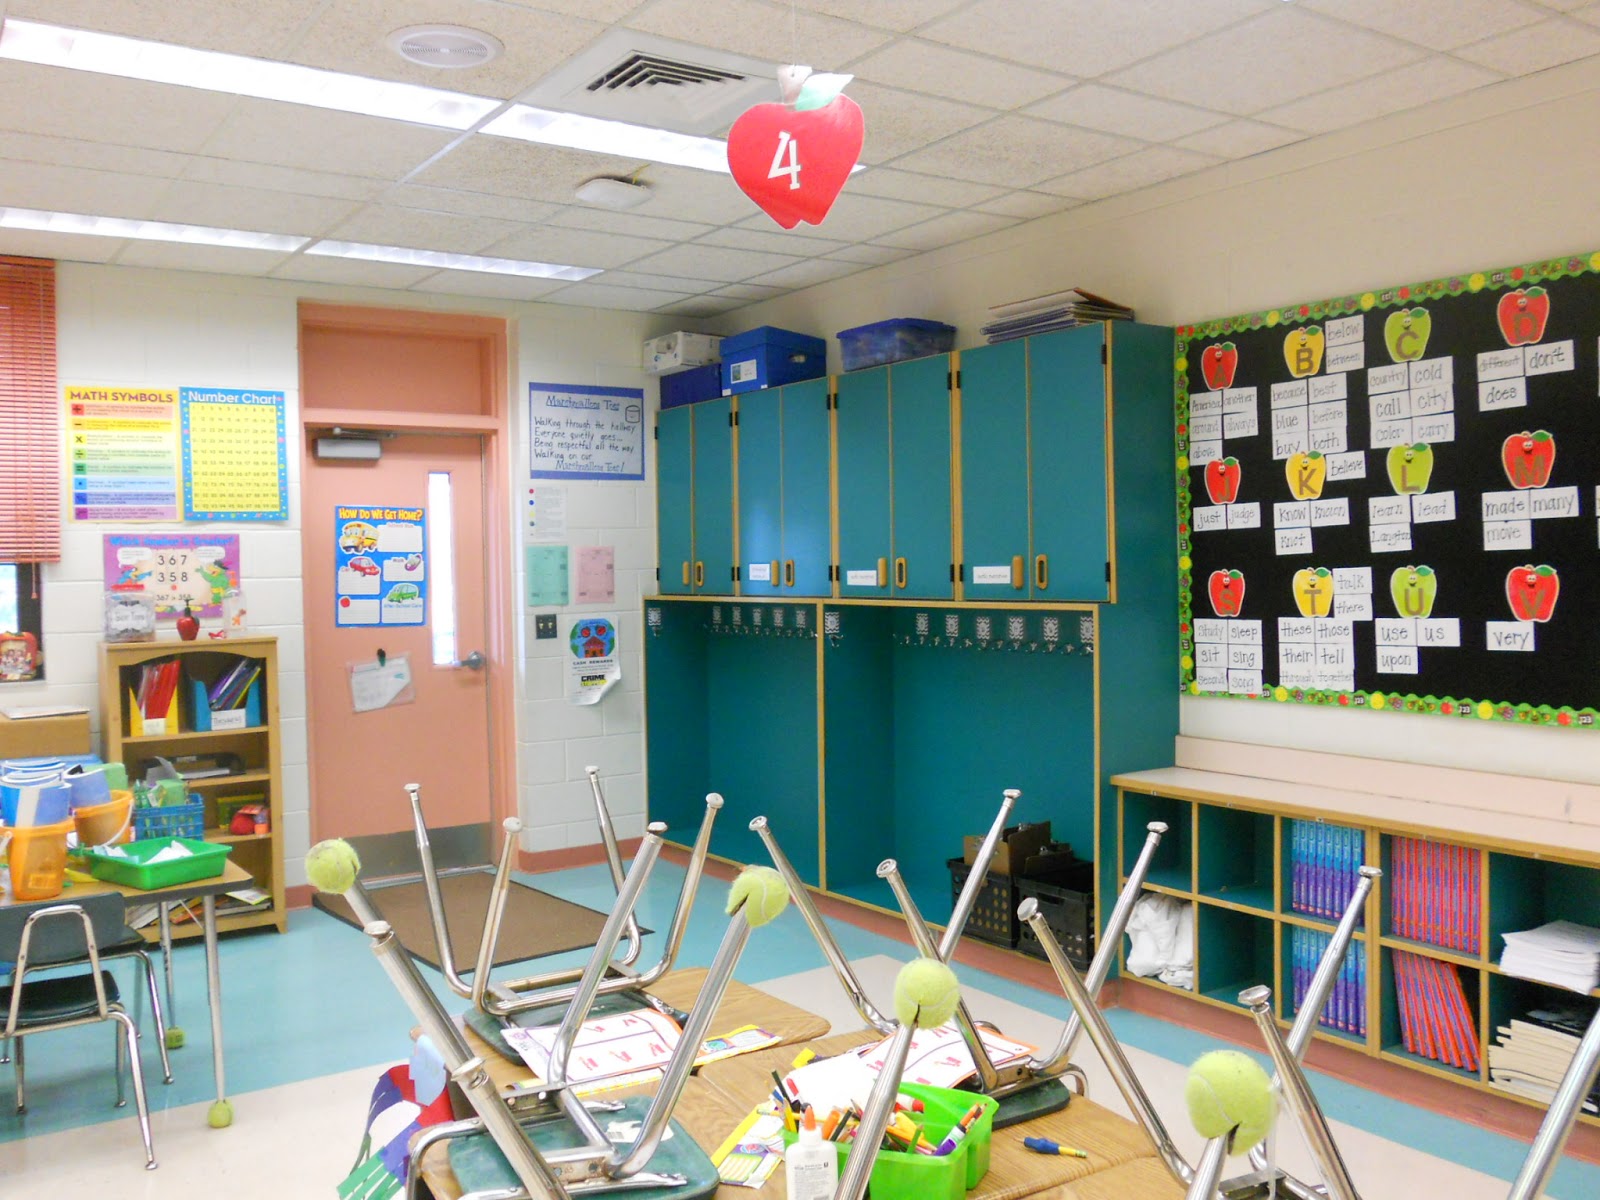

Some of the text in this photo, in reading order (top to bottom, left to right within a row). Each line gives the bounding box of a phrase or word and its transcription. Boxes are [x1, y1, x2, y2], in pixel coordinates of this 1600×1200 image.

[768, 131, 801, 190] 4
[1327, 321, 1360, 340] below
[1513, 312, 1538, 340] D
[1396, 331, 1420, 359] C
[1296, 348, 1314, 374] B
[1327, 353, 1361, 367] between
[1529, 347, 1565, 368] don't
[1211, 364, 1229, 388] A
[1369, 369, 1407, 387] country
[1414, 366, 1442, 384] cold
[70, 391, 173, 403] MATH SYMBOLS
[188, 391, 277, 404] Number Chart
[1272, 383, 1307, 401] because
[1313, 382, 1337, 399] best
[1486, 387, 1517, 404] does
[1375, 397, 1401, 417] call
[1417, 391, 1448, 410] city
[534, 416, 560, 426] Walking
[1275, 413, 1299, 430] blue
[1312, 408, 1344, 424] before
[534, 427, 565, 439] Everyone
[570, 432, 594, 441] quietly
[1375, 426, 1405, 442] color
[1418, 423, 1449, 439] carry
[534, 438, 553, 448] Being
[558, 441, 591, 451] respectful
[1276, 440, 1300, 457] buy
[1312, 432, 1340, 450] both
[534, 449, 564, 460] Walking
[1192, 446, 1215, 459] above
[1330, 456, 1364, 477] believe
[1514, 455, 1546, 486] M
[1299, 468, 1319, 495] K
[1401, 465, 1420, 491] L
[1371, 504, 1404, 518] learn
[1418, 500, 1446, 516] lead
[1485, 498, 1525, 516] made
[1533, 493, 1575, 514] many
[1197, 512, 1221, 529] just
[1229, 507, 1255, 525] judge
[1486, 526, 1522, 541] move
[157, 555, 187, 566] 3 6 7
[157, 572, 188, 582] 3 5 8
[1220, 589, 1235, 614] S
[1303, 589, 1322, 615] T
[1336, 602, 1364, 614] there
[1404, 588, 1425, 615] U
[1520, 588, 1546, 619] V
[1281, 623, 1312, 636] these
[1317, 624, 1350, 638] those
[1381, 628, 1409, 642] use
[1424, 627, 1445, 642] us
[1493, 630, 1530, 650] very
[1201, 646, 1220, 659] sit
[1233, 649, 1255, 667] sing
[1283, 648, 1313, 664] their
[1321, 647, 1344, 664] tell
[1381, 653, 1412, 671] upon
[581, 674, 605, 682] CRIME
[1232, 676, 1254, 693] song
